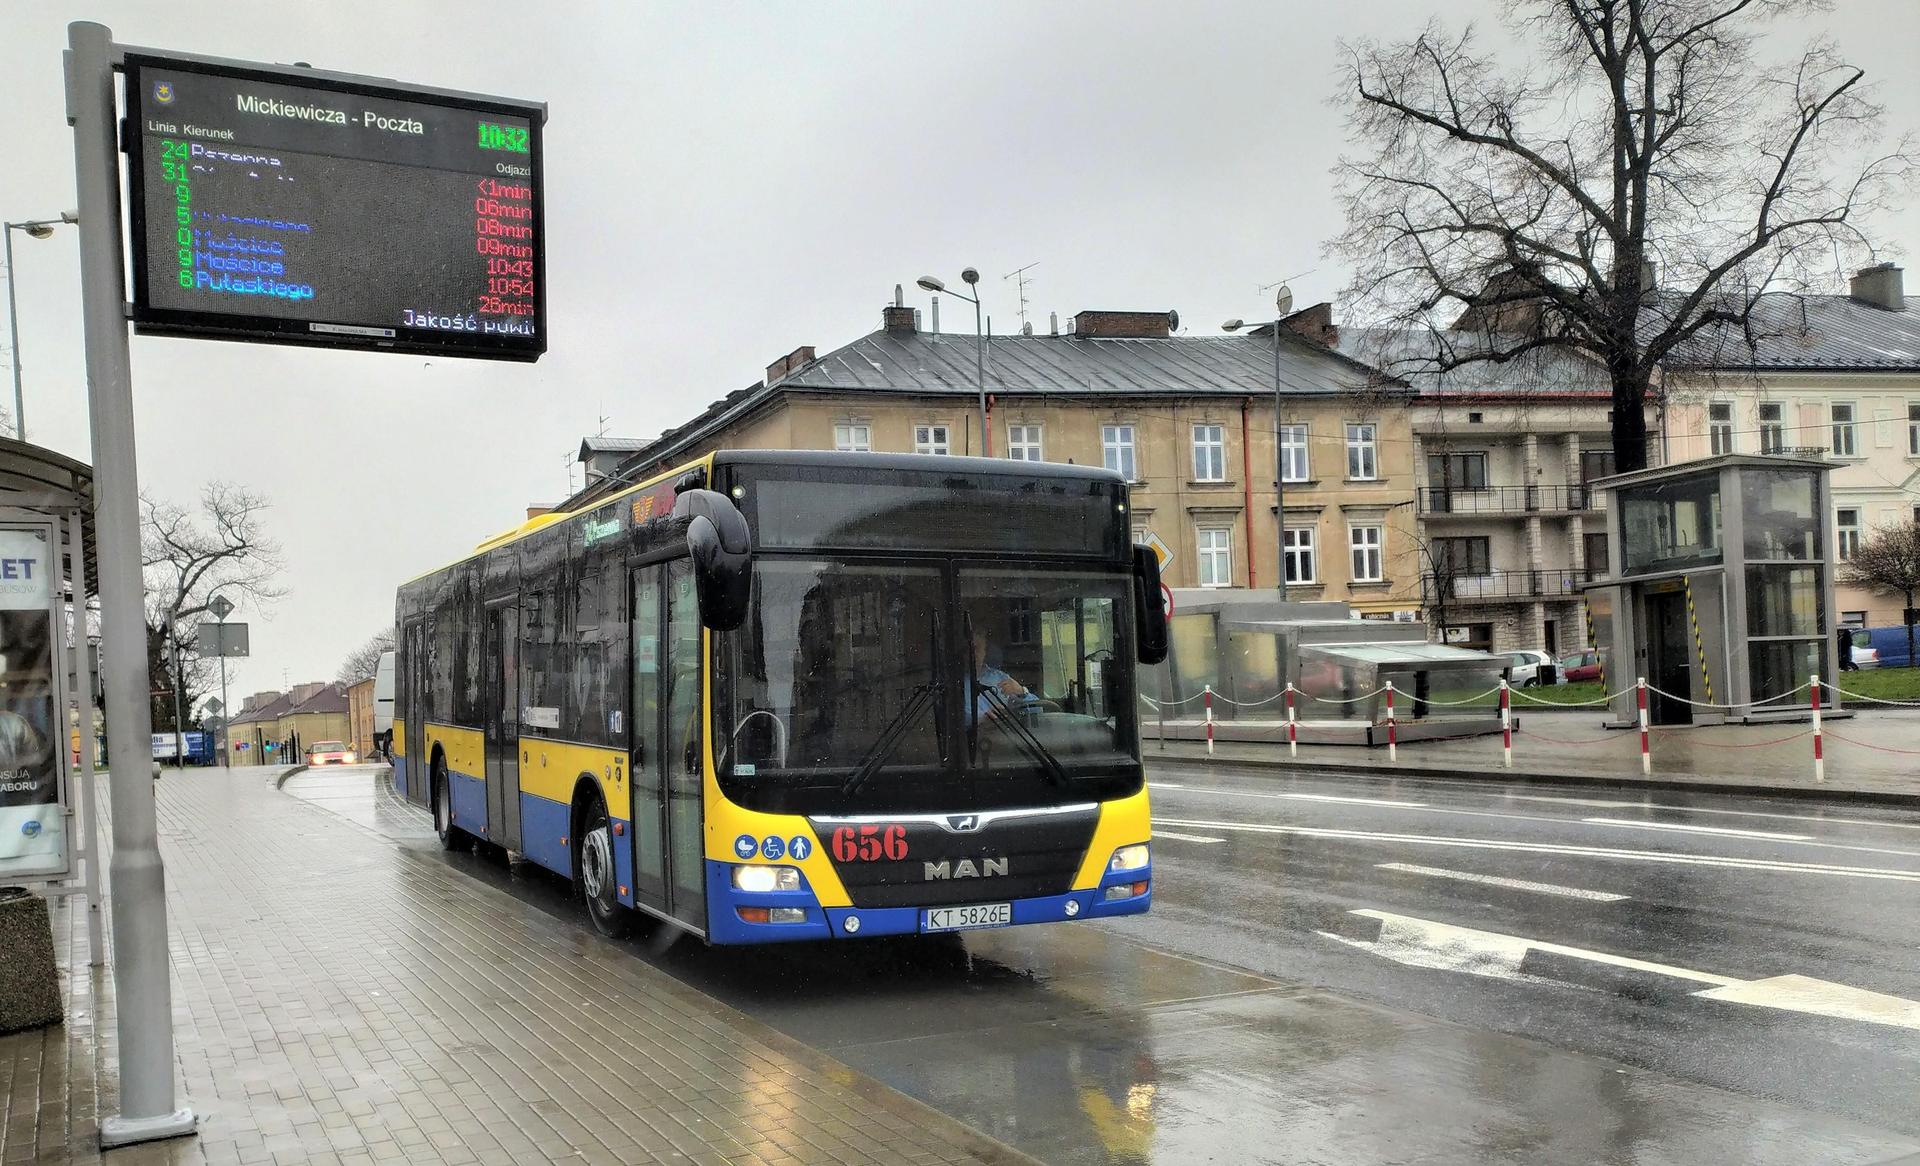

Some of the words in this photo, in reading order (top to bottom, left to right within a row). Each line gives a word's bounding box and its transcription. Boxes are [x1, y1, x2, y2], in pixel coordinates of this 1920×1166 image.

[237, 94, 346, 124] Mickiewicza
[363, 111, 424, 135] Poczta
[148, 120, 177, 133] Linia
[183, 124, 235, 140] Kierunek
[478, 122, 529, 153] 10:32
[161, 139, 189, 161] 24
[495, 162, 531, 176] Odjazd
[162, 161, 189, 183] 31
[476, 197, 532, 219] 06min
[176, 205, 191, 224] 5
[476, 237, 533, 258] 09min
[476, 217, 532, 239] 08min
[179, 248, 192, 267] 9
[487, 277, 534, 297] 10:54
[487, 257, 533, 278] 10:43
[180, 270, 193, 289] 6
[403, 309, 477, 331] Jakość
[0, 558, 37, 580] ET
[0, 781, 37, 793] ABORU
[832, 825, 909, 862] 656
[924, 857, 1009, 880] MAN
[930, 910, 953, 928] KT
[960, 905, 1009, 925] 5826E
